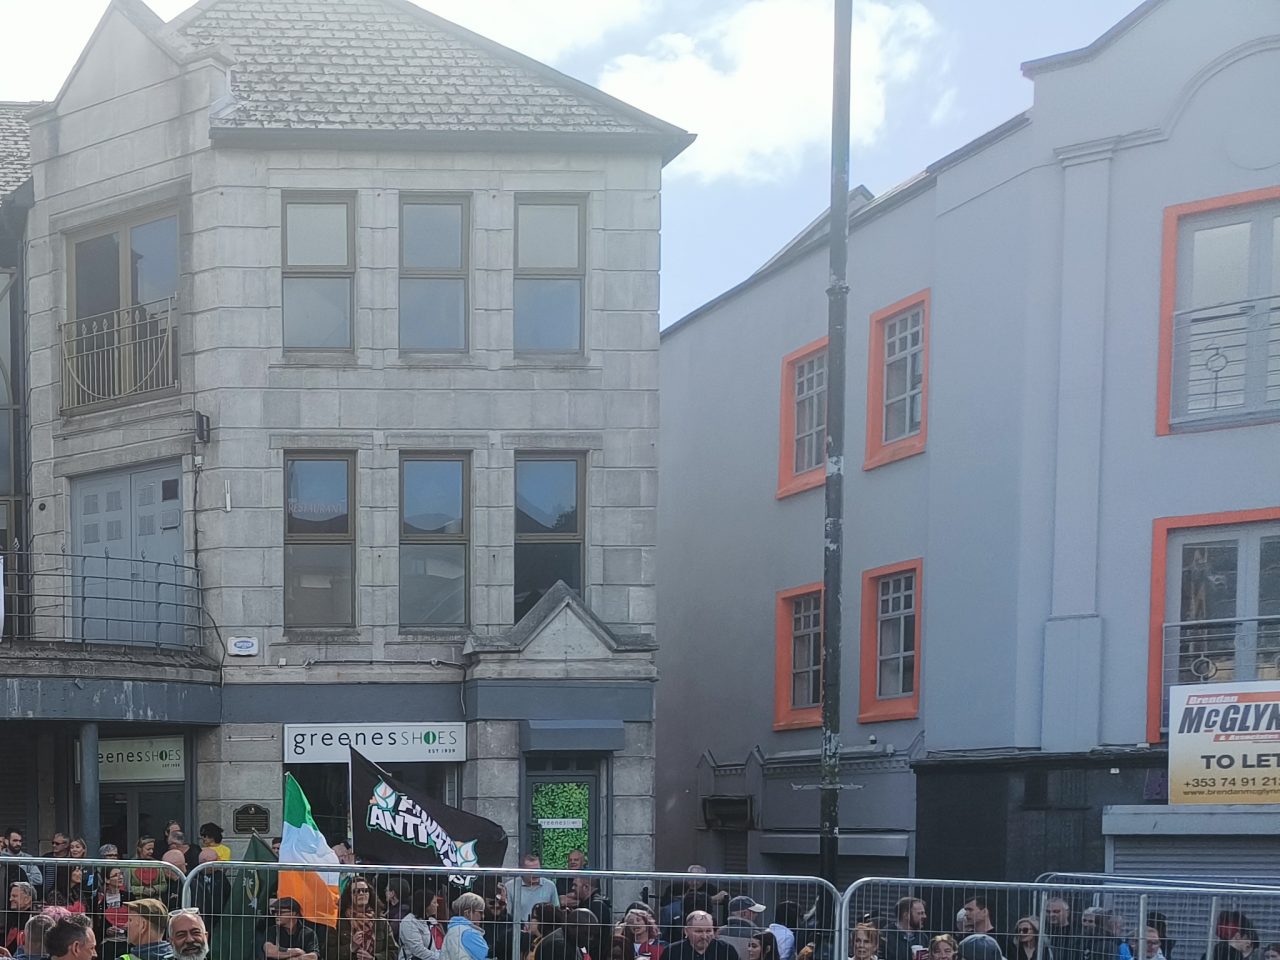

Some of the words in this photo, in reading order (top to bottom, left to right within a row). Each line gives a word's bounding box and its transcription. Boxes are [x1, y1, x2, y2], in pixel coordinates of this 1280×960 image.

[1188, 695, 1238, 705] Brendan
[1200, 754, 1235, 769] TO
[1184, 778, 1216, 788] +353
[1220, 777, 1236, 787] 74
[1241, 777, 1256, 786] 91
[1262, 776, 1280, 786] 21
